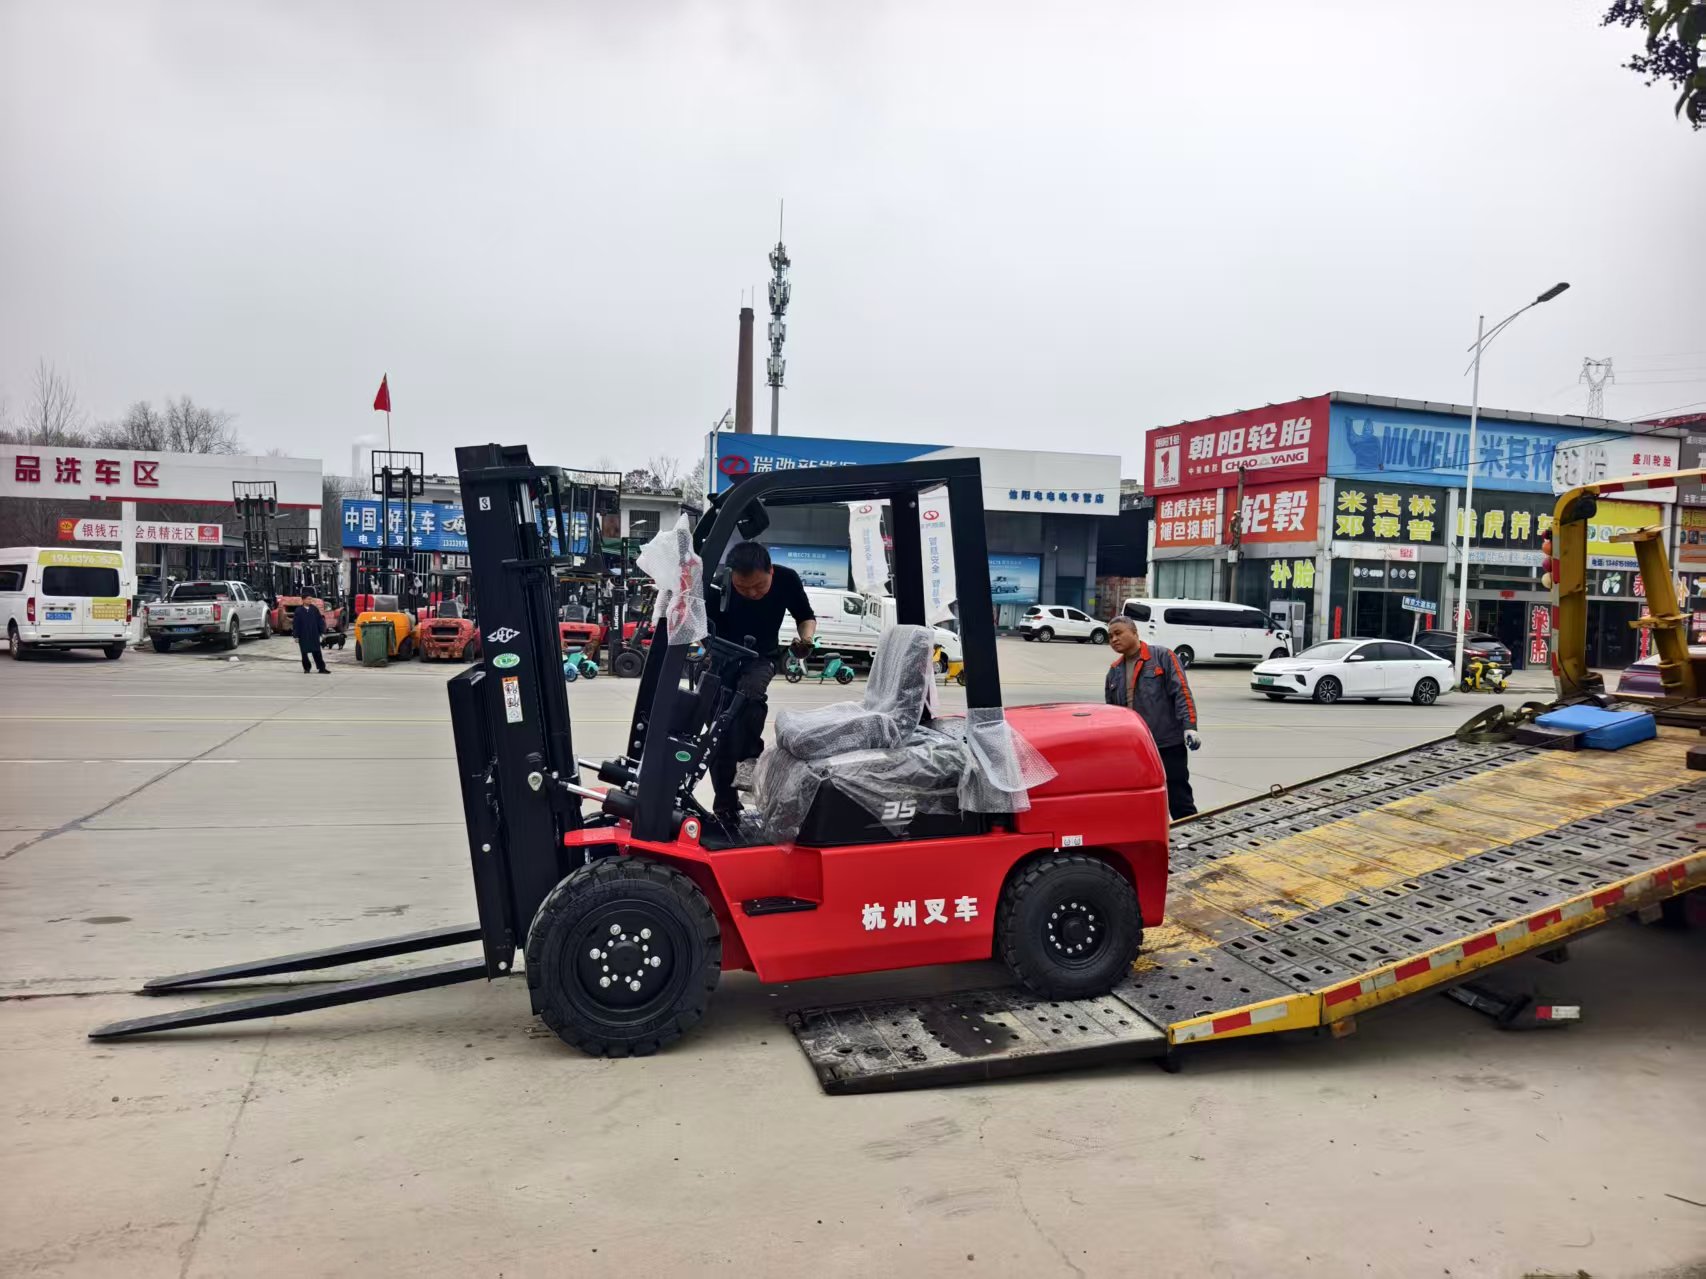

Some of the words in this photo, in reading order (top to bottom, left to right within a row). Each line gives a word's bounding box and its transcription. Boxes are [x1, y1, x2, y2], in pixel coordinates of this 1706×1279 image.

[1188, 417, 1312, 461] 朝阳轮胎
[1381, 426, 1470, 471] MICHELIN
[1225, 459, 1258, 471] CHAO
[1270, 452, 1305, 464] YANG
[1479, 434, 1557, 480] 米其林
[1632, 453, 1672, 467] 盛川轮胎
[15, 455, 159, 488] 品洗车区
[1160, 497, 1215, 519] 途虎养车
[1235, 490, 1308, 534] 轮毂
[1338, 490, 1436, 516] 米其林
[1160, 519, 1215, 541] 褪色换新
[1335, 515, 1435, 542] 邓禄普
[1270, 559, 1315, 588] 补胎
[881, 799, 916, 820] 35
[862, 896, 978, 930] 杭州叉车
